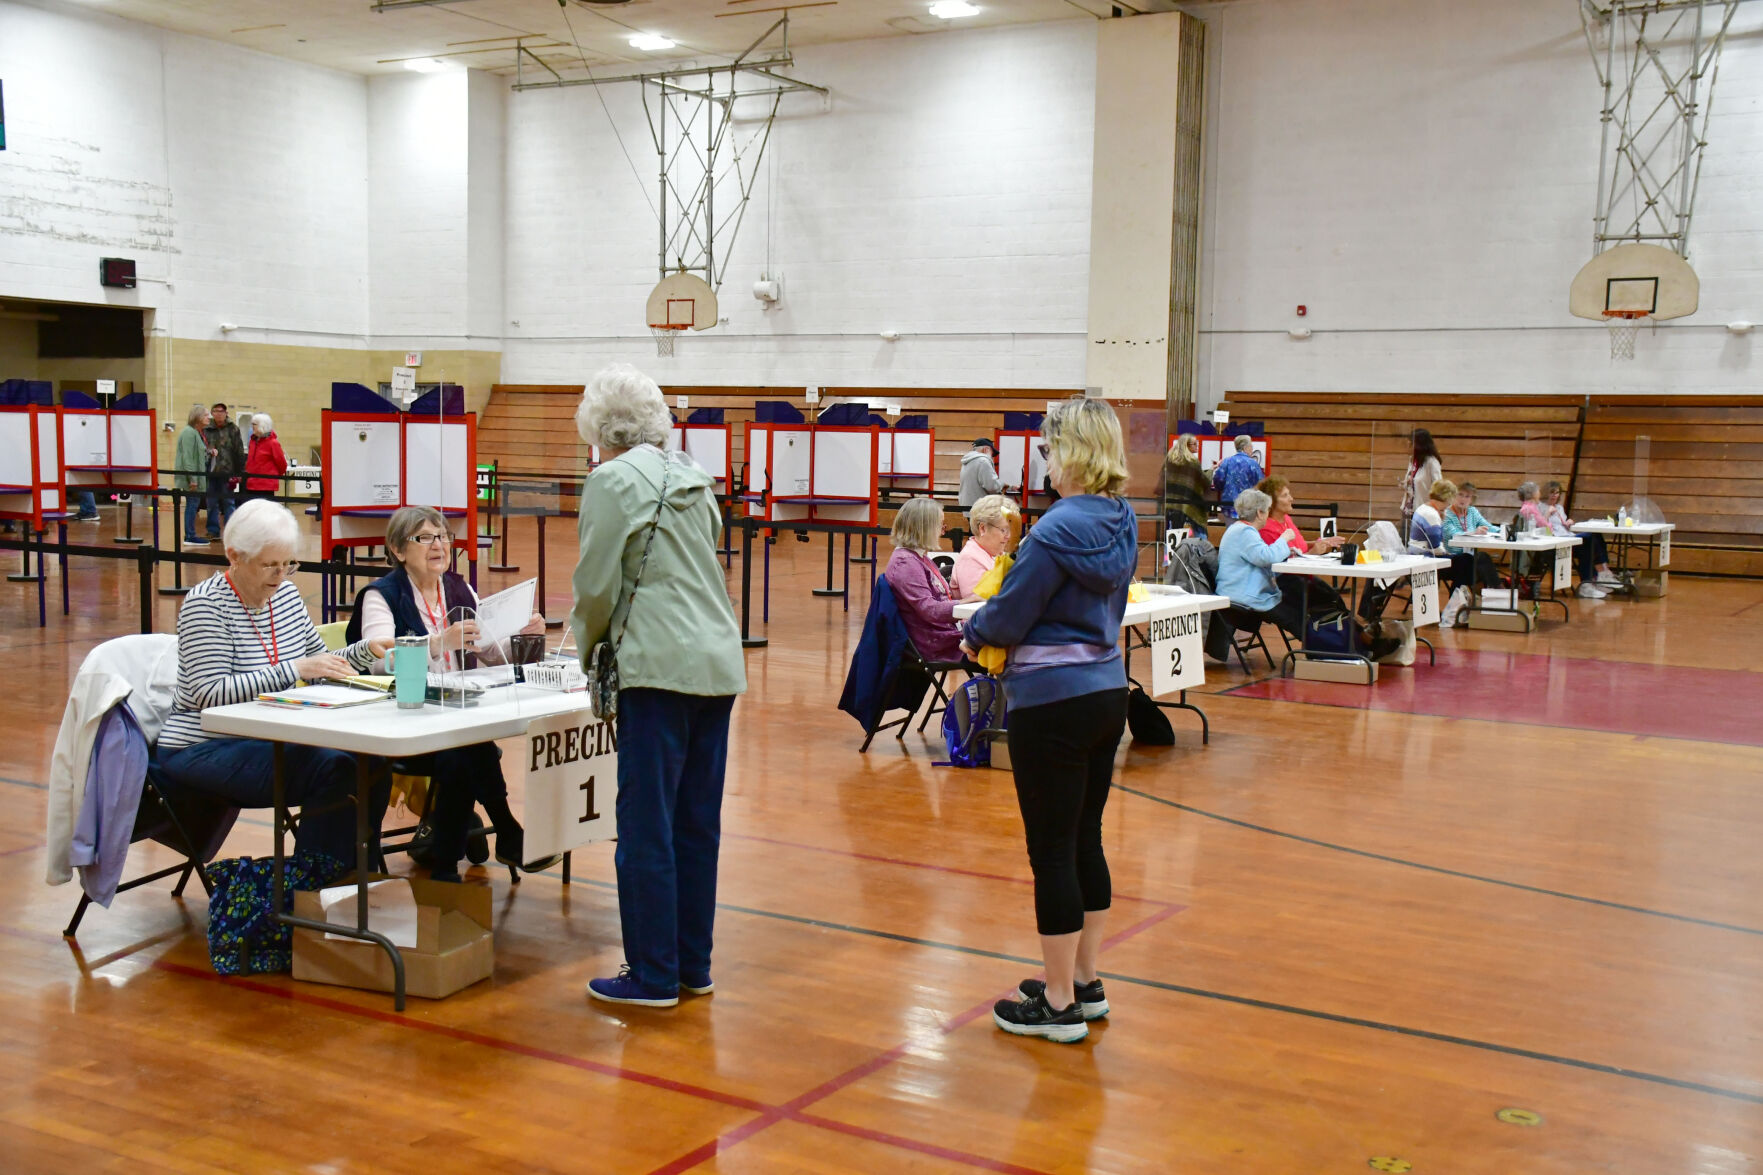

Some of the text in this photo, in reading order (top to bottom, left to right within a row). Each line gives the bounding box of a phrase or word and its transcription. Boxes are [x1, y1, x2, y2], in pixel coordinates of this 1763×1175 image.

[305, 480, 312, 490] 5
[1323, 521, 1335, 538] 4
[1412, 570, 1436, 590] PRECINCT
[1420, 594, 1428, 615] 3
[1152, 612, 1199, 642] PRECINCT
[1170, 647, 1183, 678] 2
[530, 720, 618, 772] PRECIN
[578, 775, 601, 823] 1
